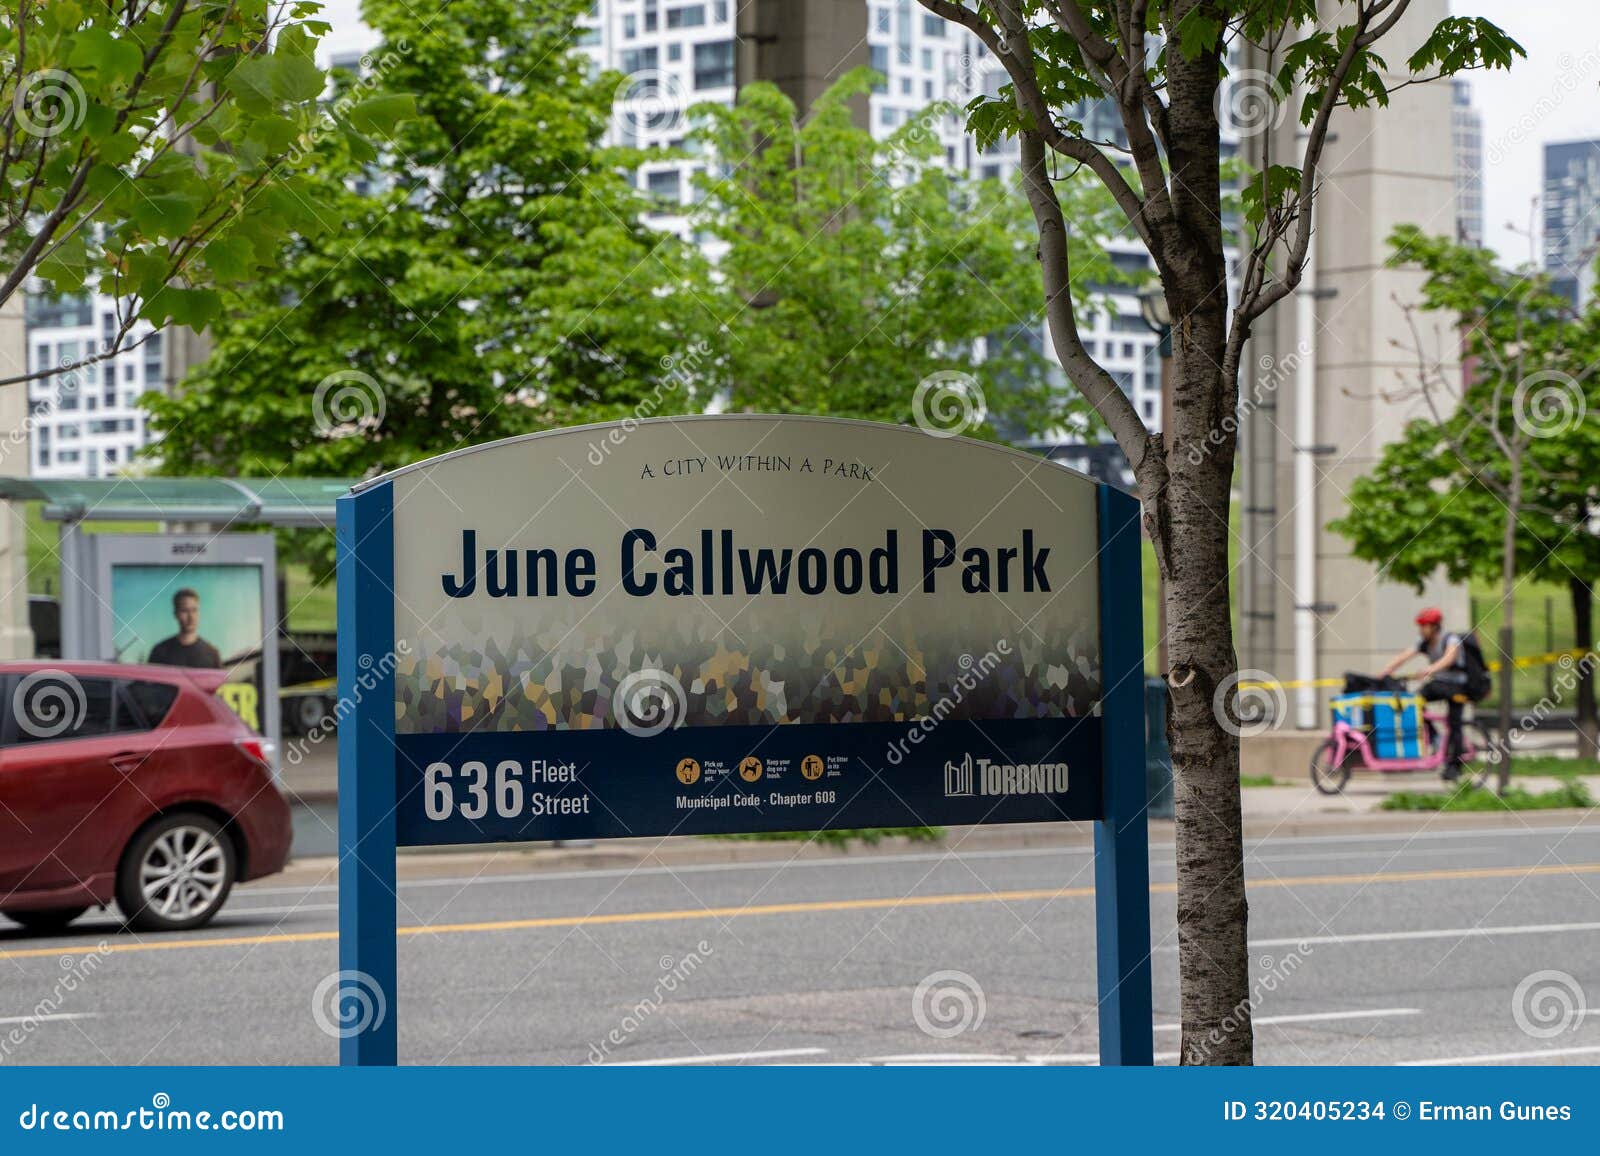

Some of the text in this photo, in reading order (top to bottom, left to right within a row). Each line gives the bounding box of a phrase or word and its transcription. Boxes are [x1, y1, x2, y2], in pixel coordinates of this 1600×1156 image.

[641, 455, 874, 481] A CITY WITHIN A PARK
[441, 528, 1052, 598] June Callwood Park
[531, 760, 577, 783] Fleet
[976, 758, 1069, 795] TORONTO
[424, 760, 524, 821] 636
[676, 794, 731, 811] Municipal
[733, 793, 761, 807] Code
[769, 792, 813, 808] Chapter
[815, 791, 836, 804] 608
[531, 792, 590, 816] Street
